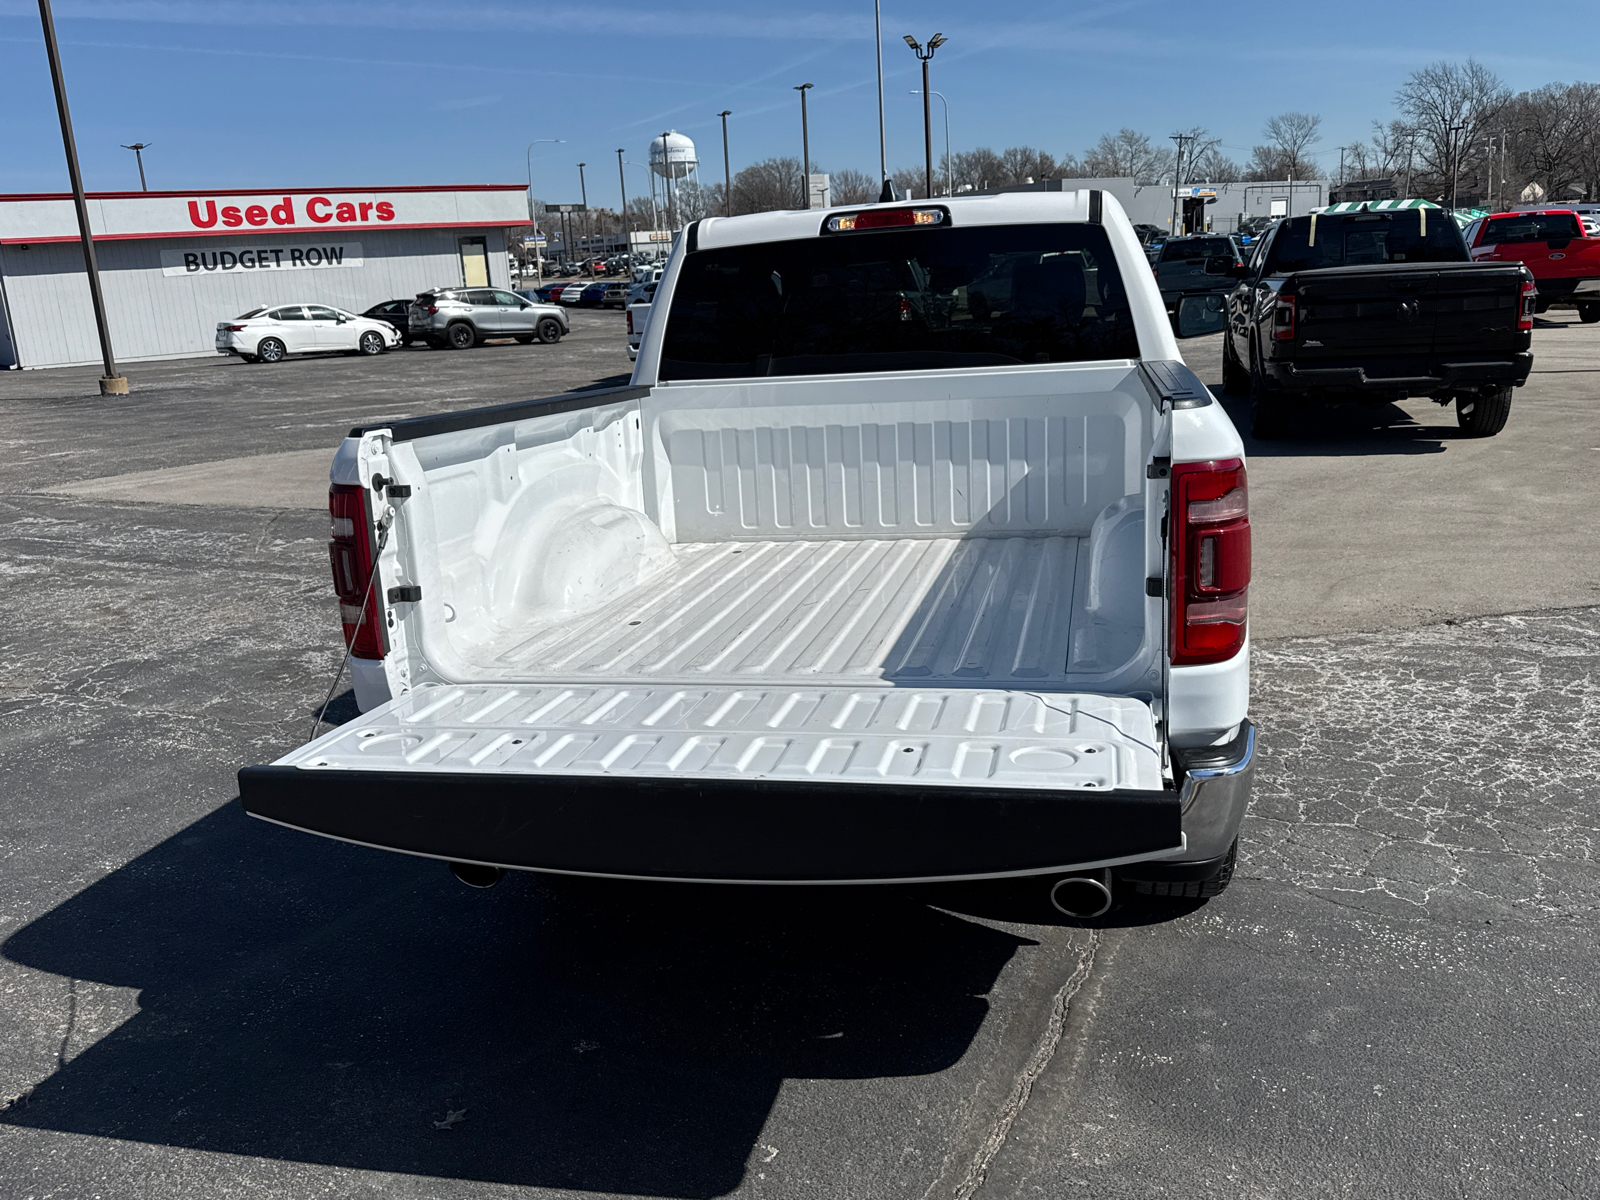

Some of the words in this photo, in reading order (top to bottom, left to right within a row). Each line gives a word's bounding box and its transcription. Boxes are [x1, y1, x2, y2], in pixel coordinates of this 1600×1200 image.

[187, 196, 296, 229] Used
[306, 196, 396, 223] Cars
[183, 248, 284, 273] BUDGET
[289, 246, 345, 268] ROW
